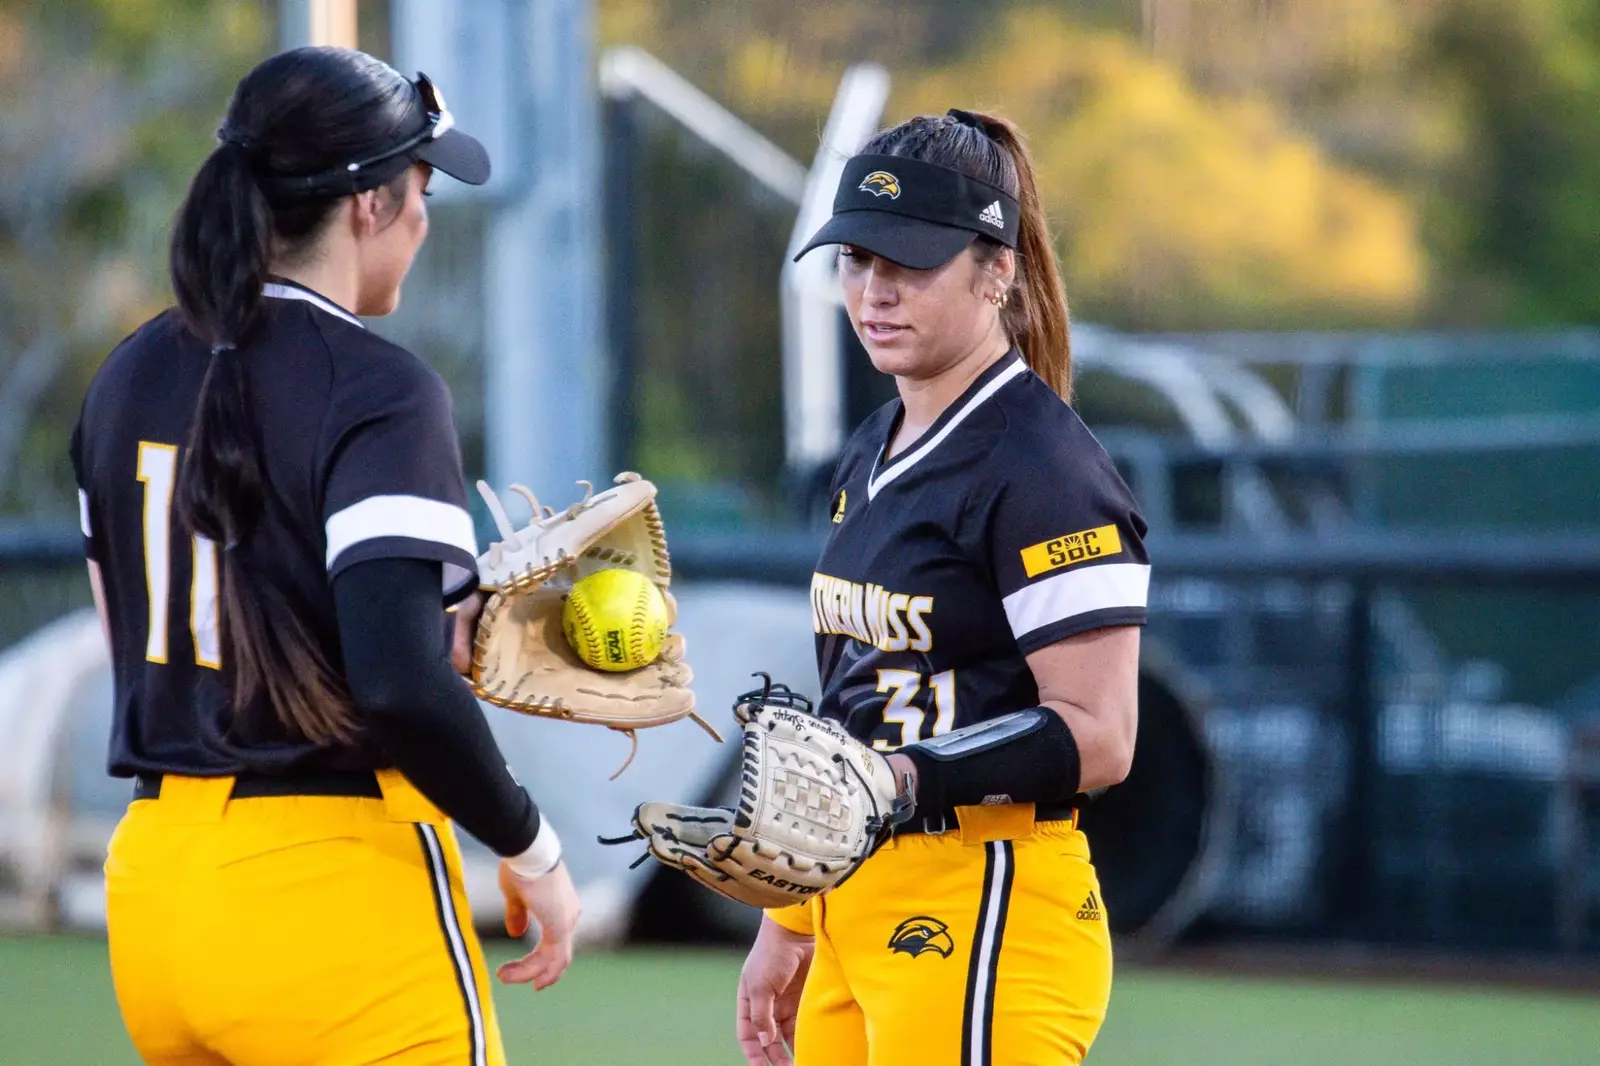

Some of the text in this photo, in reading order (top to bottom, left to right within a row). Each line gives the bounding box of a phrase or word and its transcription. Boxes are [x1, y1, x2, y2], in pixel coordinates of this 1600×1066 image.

[979, 213, 1005, 229] adidas
[1046, 530, 1102, 566] SBC
[865, 582, 934, 652] MISS
[606, 629, 624, 664] NCAA
[872, 668, 955, 752] 31
